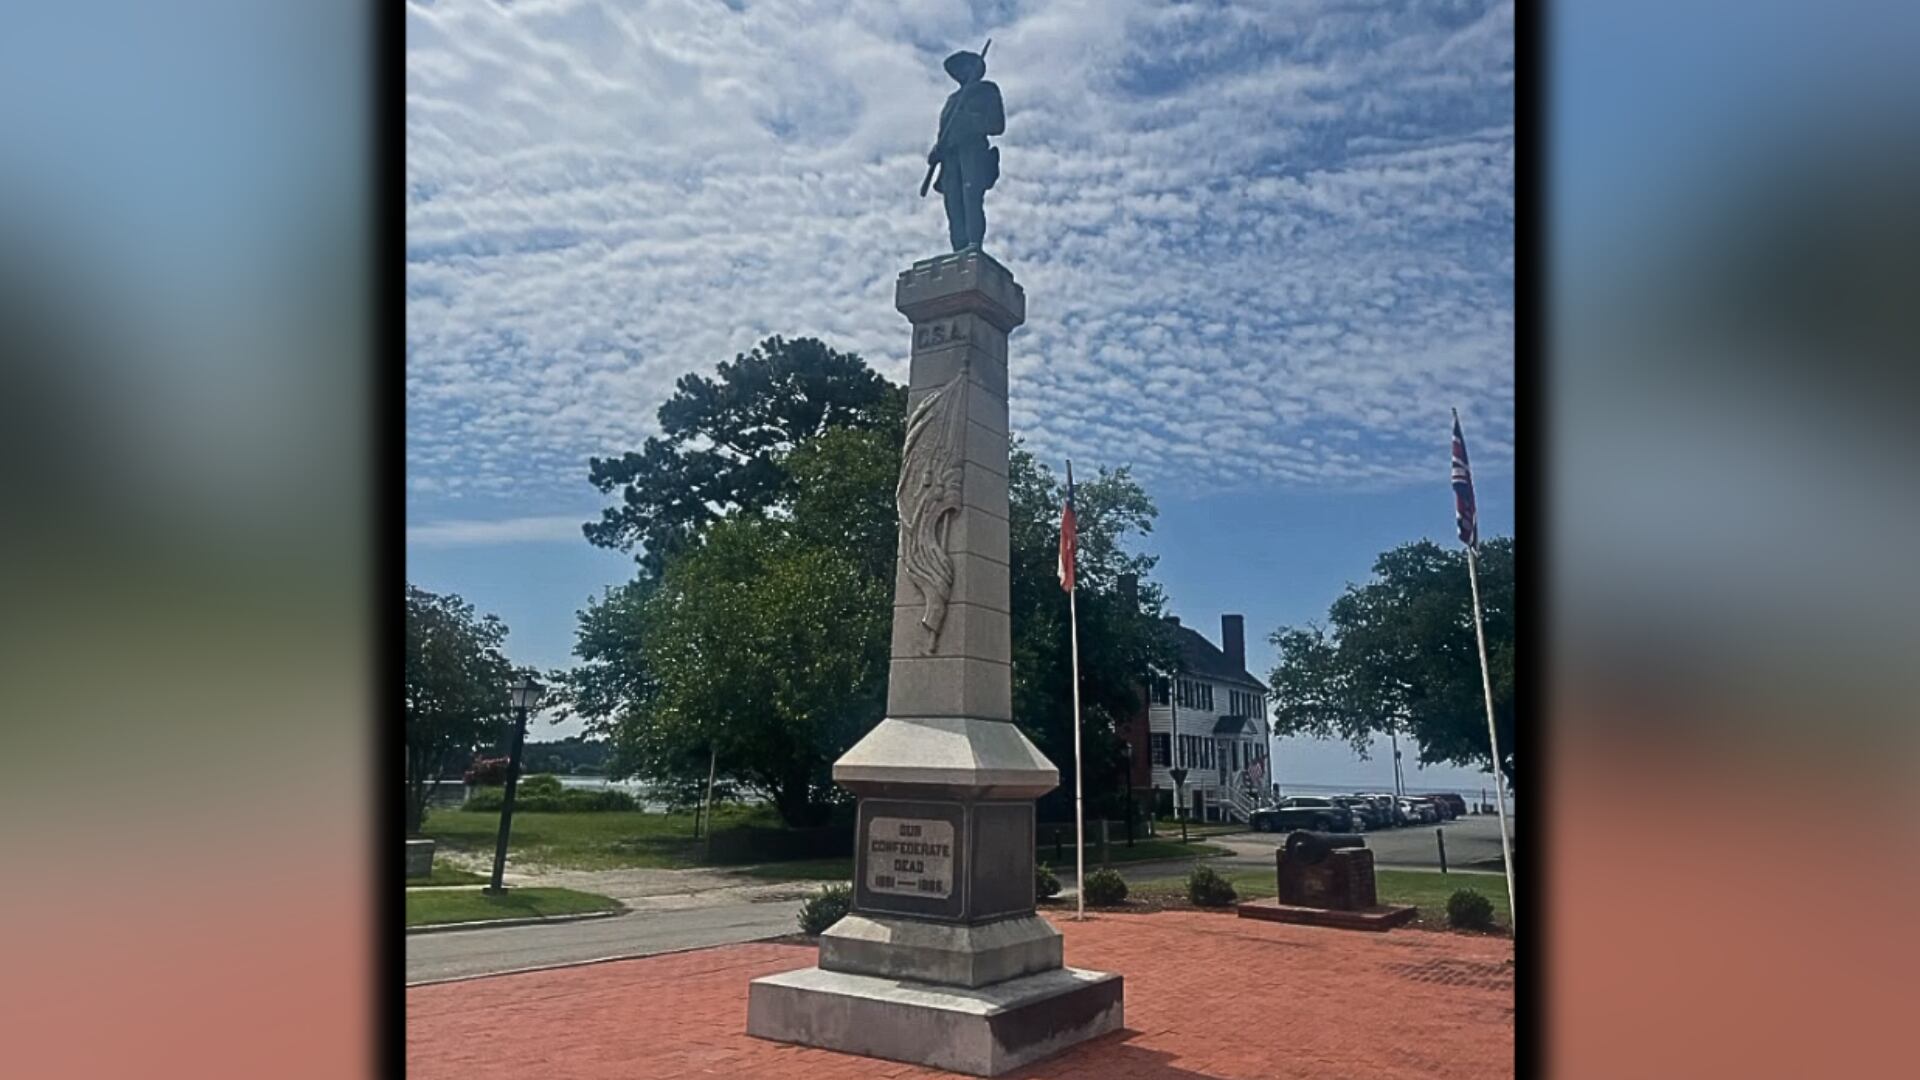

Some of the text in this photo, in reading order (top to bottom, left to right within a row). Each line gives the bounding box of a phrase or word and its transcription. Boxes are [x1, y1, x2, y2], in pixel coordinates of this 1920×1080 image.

[899, 823, 922, 837] OUR
[871, 840, 951, 858] CONFEDERATE
[894, 859, 925, 874] DEAD
